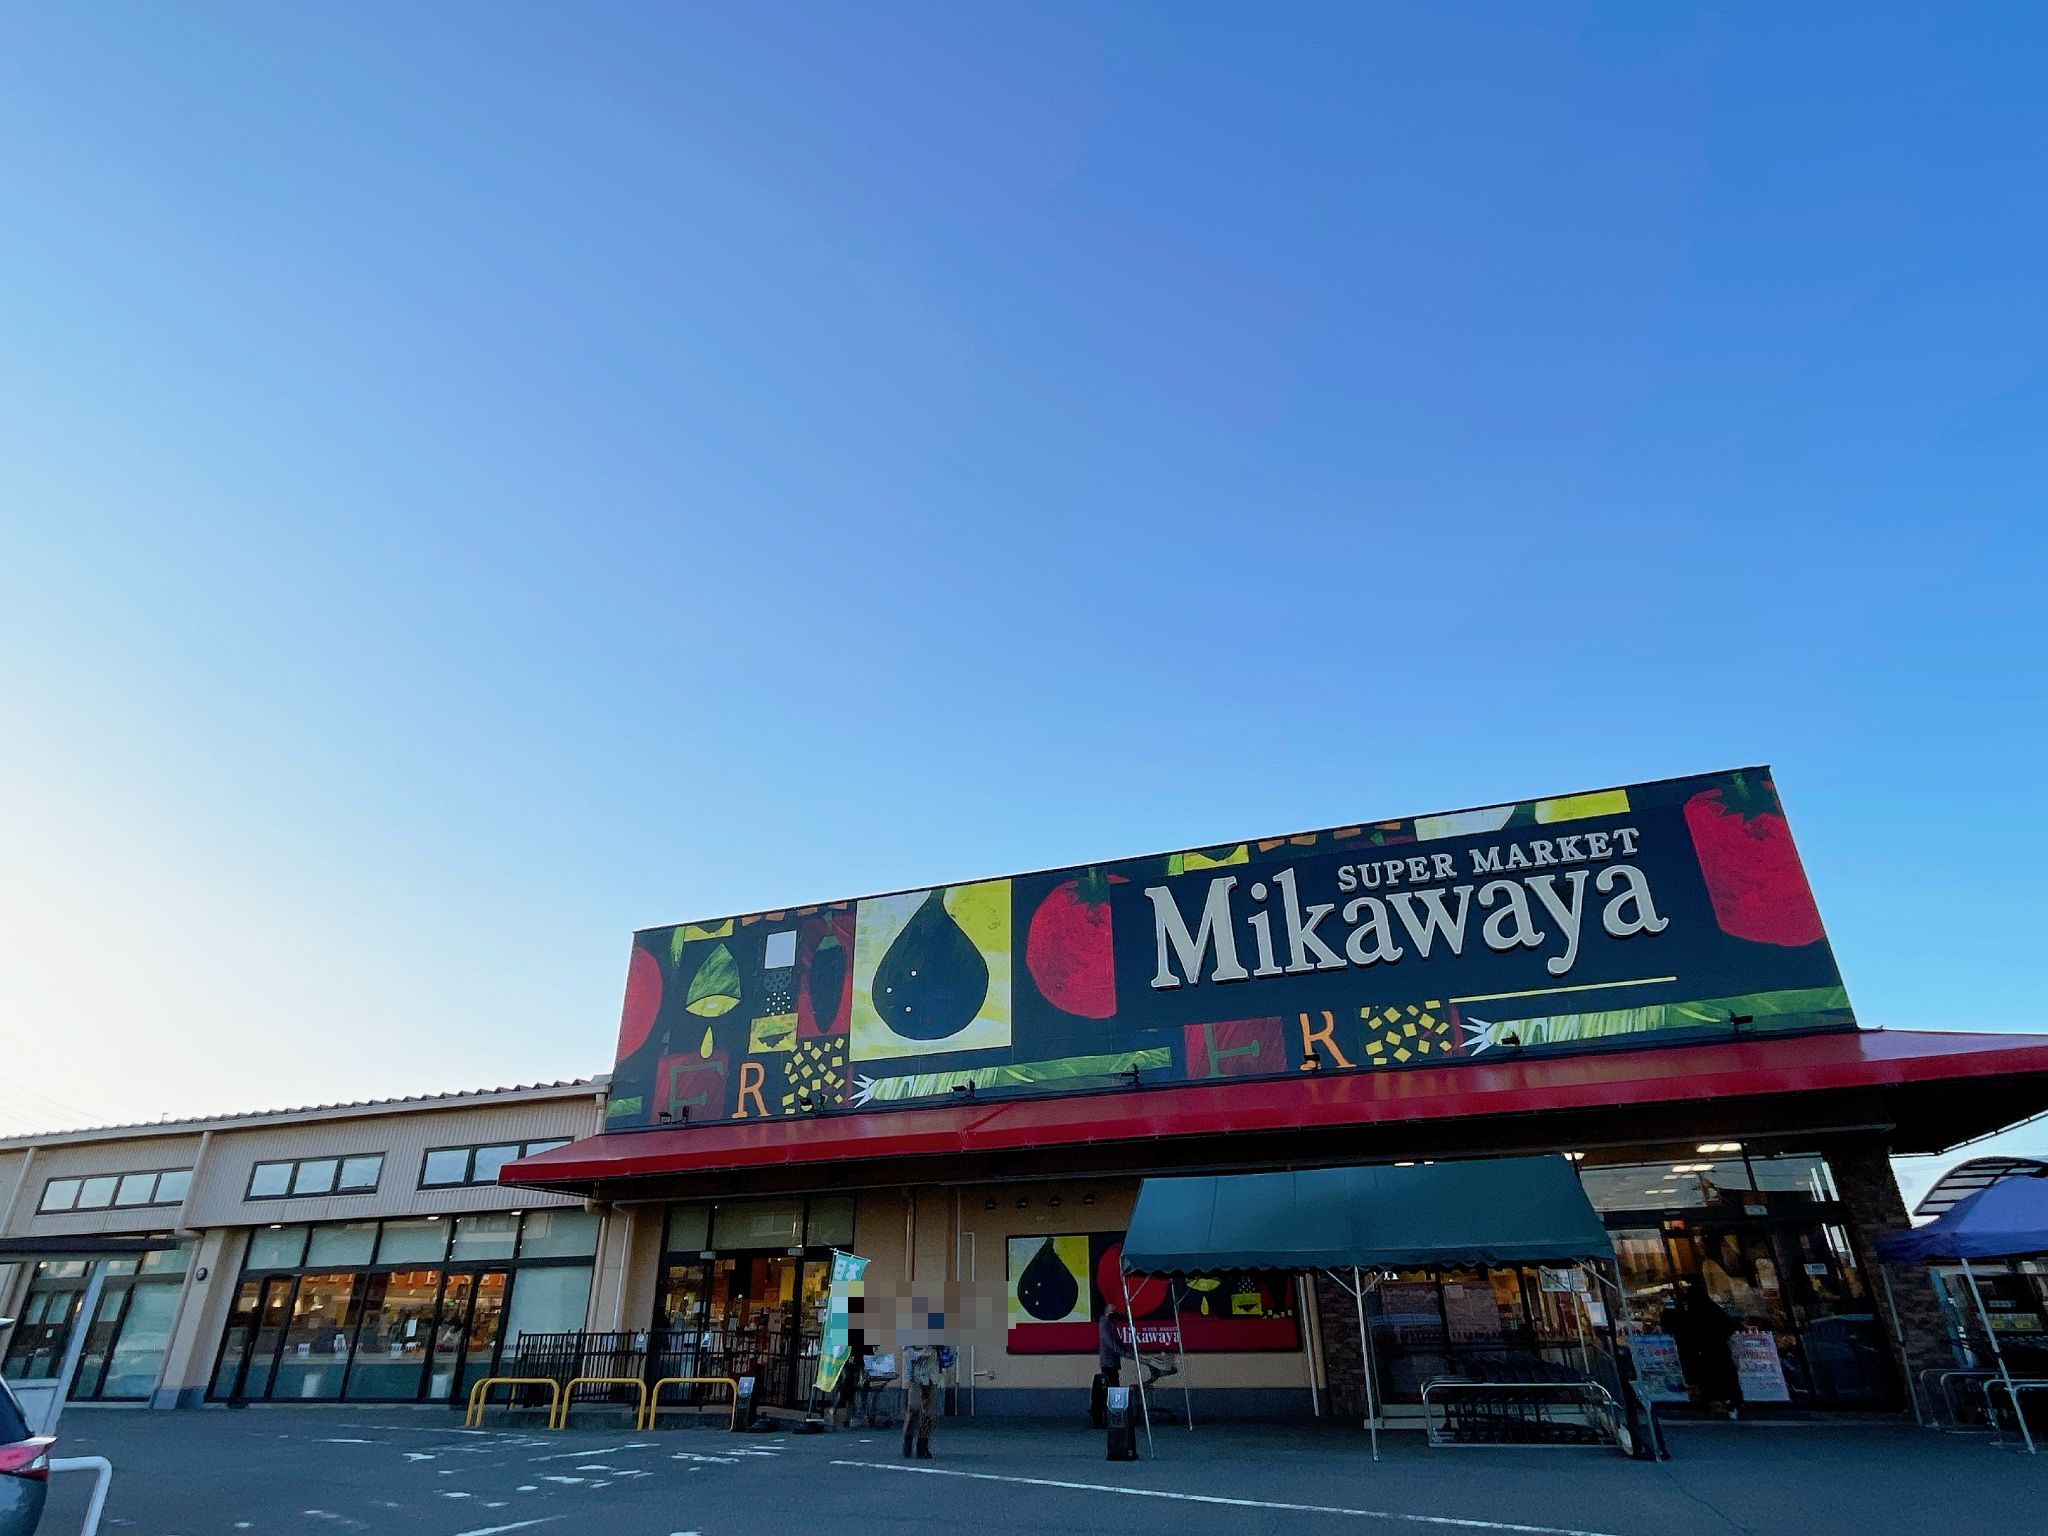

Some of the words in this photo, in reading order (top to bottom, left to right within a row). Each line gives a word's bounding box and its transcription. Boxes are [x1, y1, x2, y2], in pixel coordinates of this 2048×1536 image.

[1337, 853, 1457, 892] SUPER
[1469, 827, 1639, 875] MARKET
[1144, 863, 1669, 989] Mikawaya
[731, 1062, 773, 1118] R
